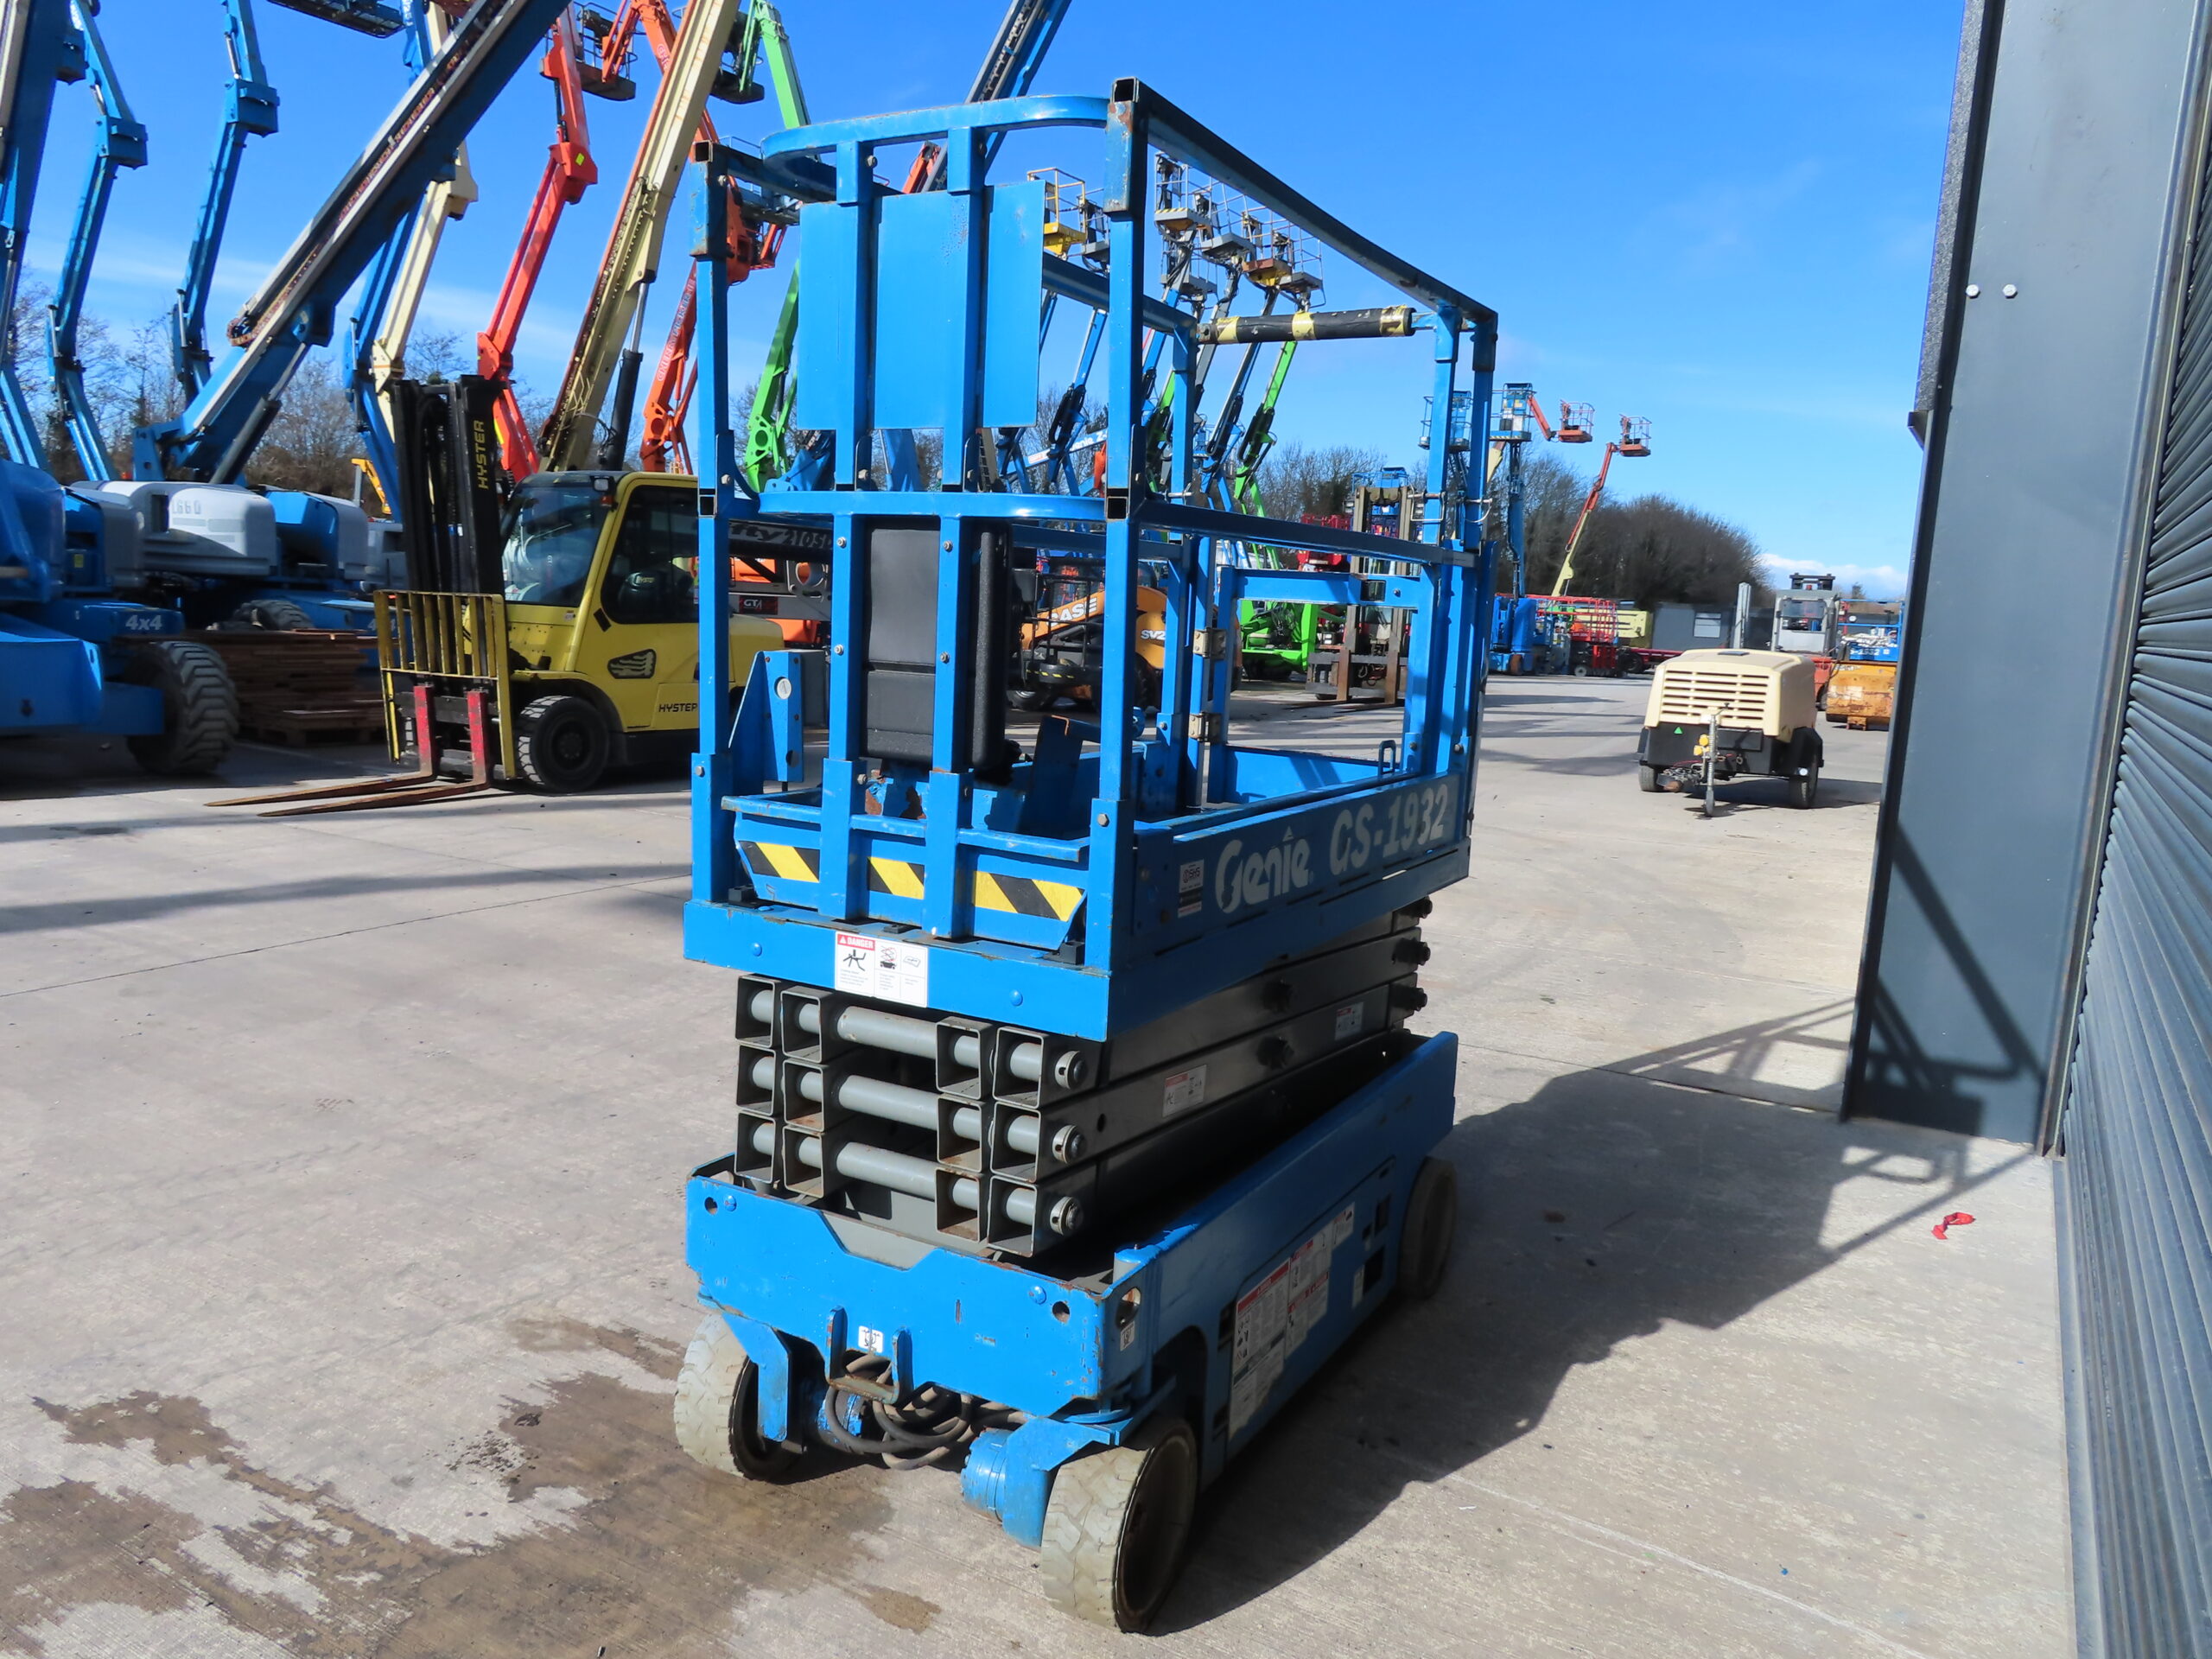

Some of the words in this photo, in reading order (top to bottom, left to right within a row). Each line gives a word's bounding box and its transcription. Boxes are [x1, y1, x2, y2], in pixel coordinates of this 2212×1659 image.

[474, 420, 489, 491] HYSTER
[125, 614, 162, 631] 4x4
[1046, 597, 1097, 627] CASE
[1215, 825, 1311, 913] Genie
[1330, 784, 1448, 875] GS-1932
[847, 937, 874, 949] DANGER
